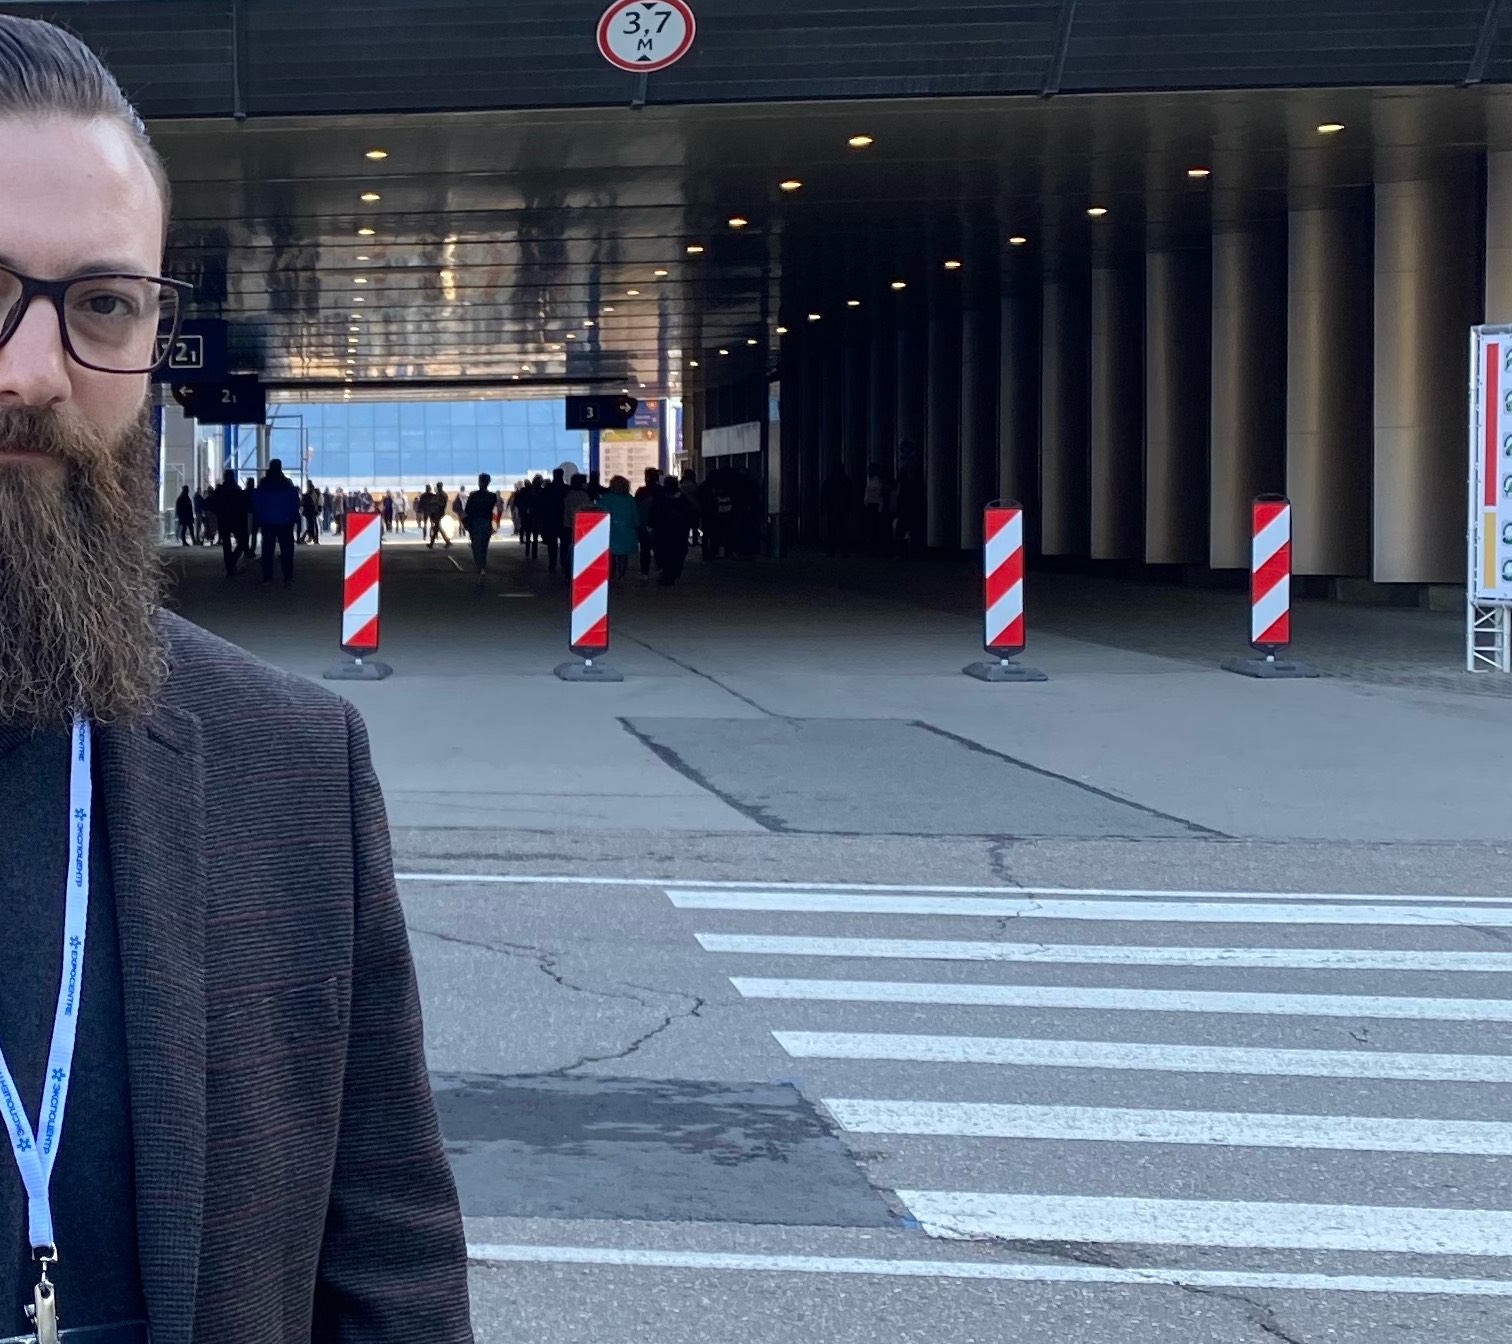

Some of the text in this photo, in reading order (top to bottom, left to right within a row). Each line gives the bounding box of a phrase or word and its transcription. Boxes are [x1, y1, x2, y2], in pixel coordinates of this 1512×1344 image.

[623, 11, 672, 37] 3,7
[586, 406, 594, 419] 3
[75, 822, 84, 888] ЭКСПОЦЕНТР
[64, 950, 78, 1016] EXPOCENTRE
[44, 1084, 61, 1154] ЭКСПОЦЕНТР
